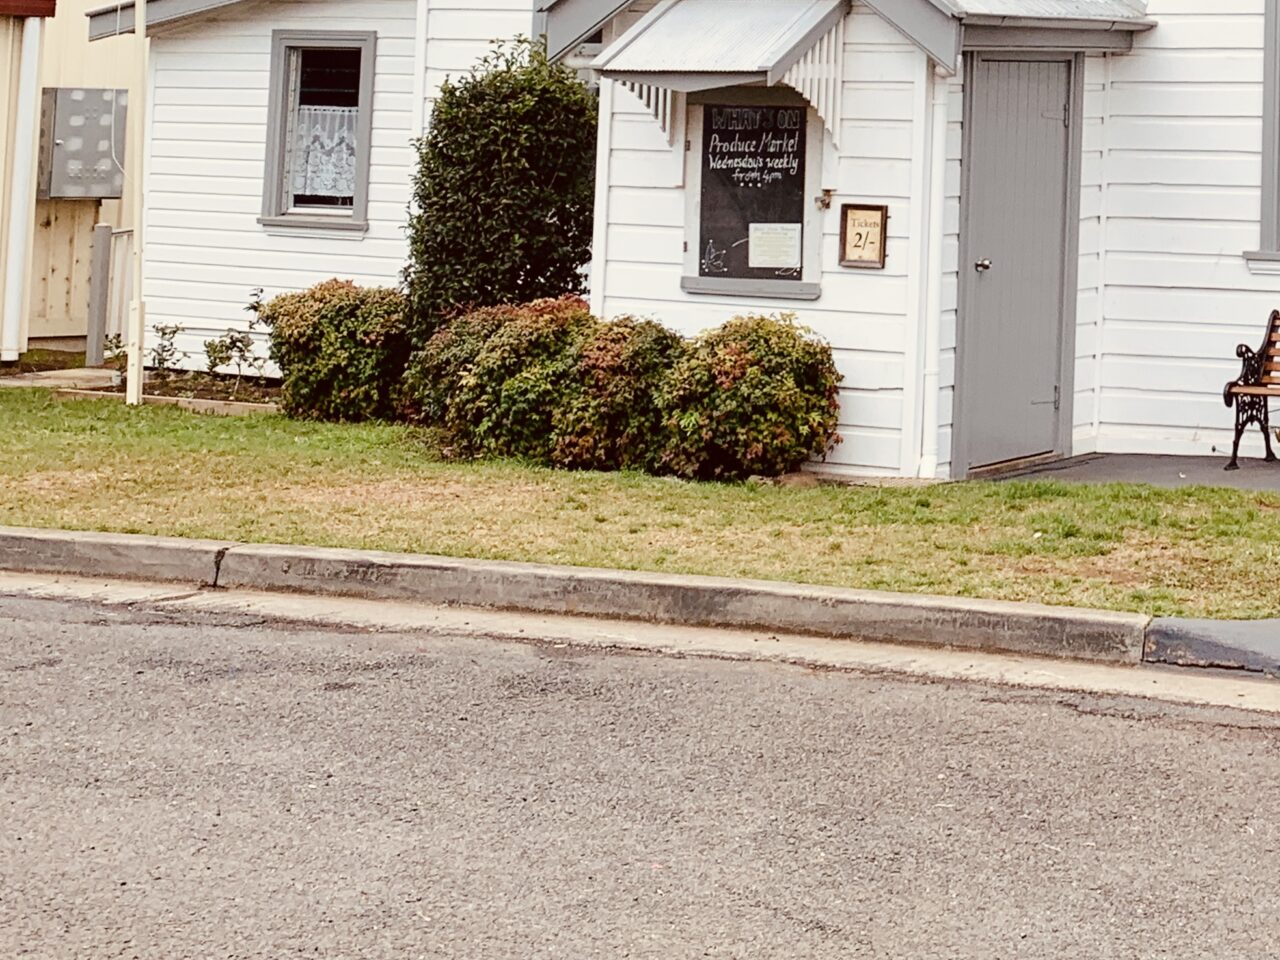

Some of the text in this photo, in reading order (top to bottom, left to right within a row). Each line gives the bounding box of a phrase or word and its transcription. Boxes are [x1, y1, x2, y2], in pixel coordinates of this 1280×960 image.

[777, 109, 800, 129] ON
[709, 131, 799, 153] Produce Market
[766, 153, 799, 175] weekly
[732, 168, 782, 183] from 4pm
[850, 217, 880, 228] Tickets
[853, 231, 876, 251] 2/-
